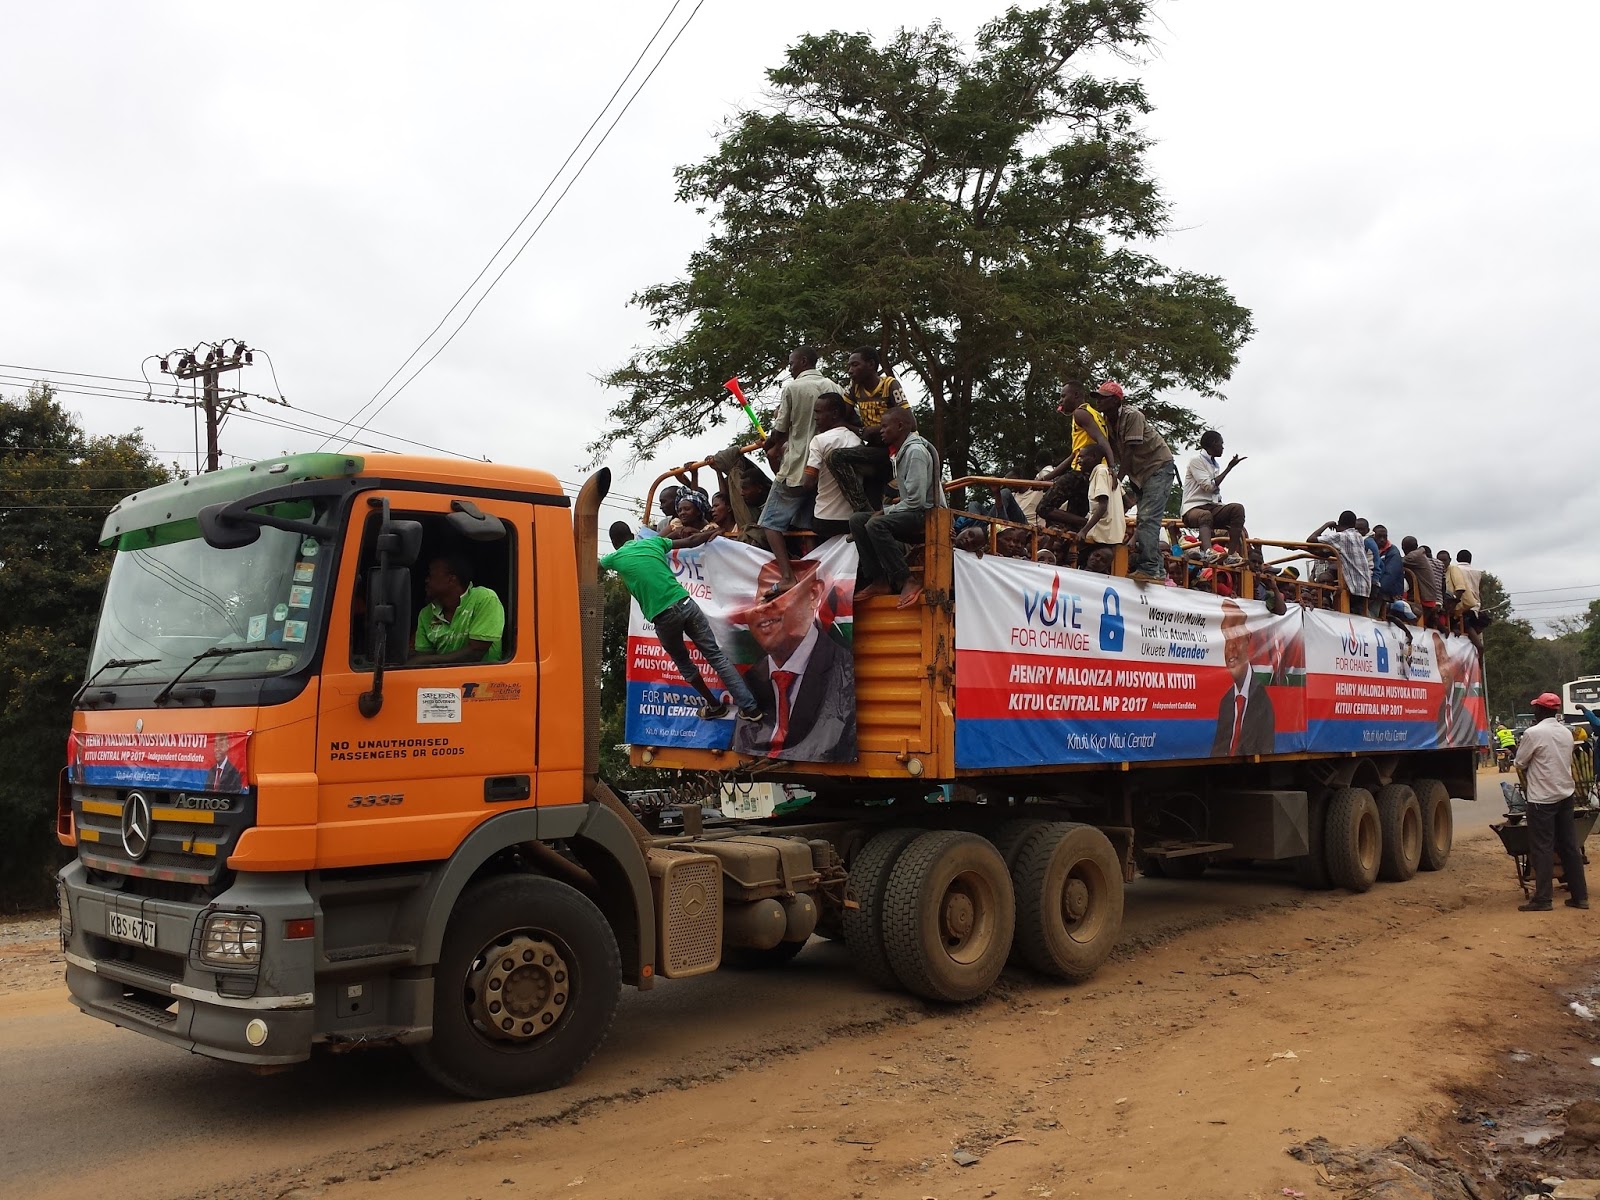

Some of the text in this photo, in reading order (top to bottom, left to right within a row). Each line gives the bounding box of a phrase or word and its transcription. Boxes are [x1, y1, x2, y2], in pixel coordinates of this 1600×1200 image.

[667, 551, 705, 580] OTE
[1023, 588, 1083, 629] VOTE
[1148, 607, 1173, 625] Wasya
[1011, 627, 1090, 651] FOR CHANGE
[1341, 632, 1369, 658] VOTE
[1141, 642, 1166, 657] Ukuete
[1335, 657, 1373, 673] FOR CHANGE
[1009, 664, 1196, 690] HENRY MALONZA MUSYOKA KITUTI
[642, 690, 660, 703] FOR
[663, 692, 680, 704] MP
[1335, 682, 1428, 700] HENRY MALONZA MUSYOKA KITUTI
[639, 704, 699, 717] KITUI CENTR
[1008, 693, 1197, 712] KITUI CENTRAL MP 2017 Independent Candidate
[1334, 702, 1353, 715] KITUI
[1353, 702, 1380, 715] CENTRAL
[1380, 703, 1390, 715] MP
[1390, 704, 1403, 716] 2017
[177, 734, 208, 748] KITUTI
[330, 738, 449, 751] NO UNAUTHORISED
[1108, 732, 1127, 749] Kitui
[84, 751, 204, 763] KITUI CENTRAL MP 2017 Independent Candidate
[330, 747, 465, 761] PASSENGERS OR GOODS
[347, 793, 405, 809] 3335
